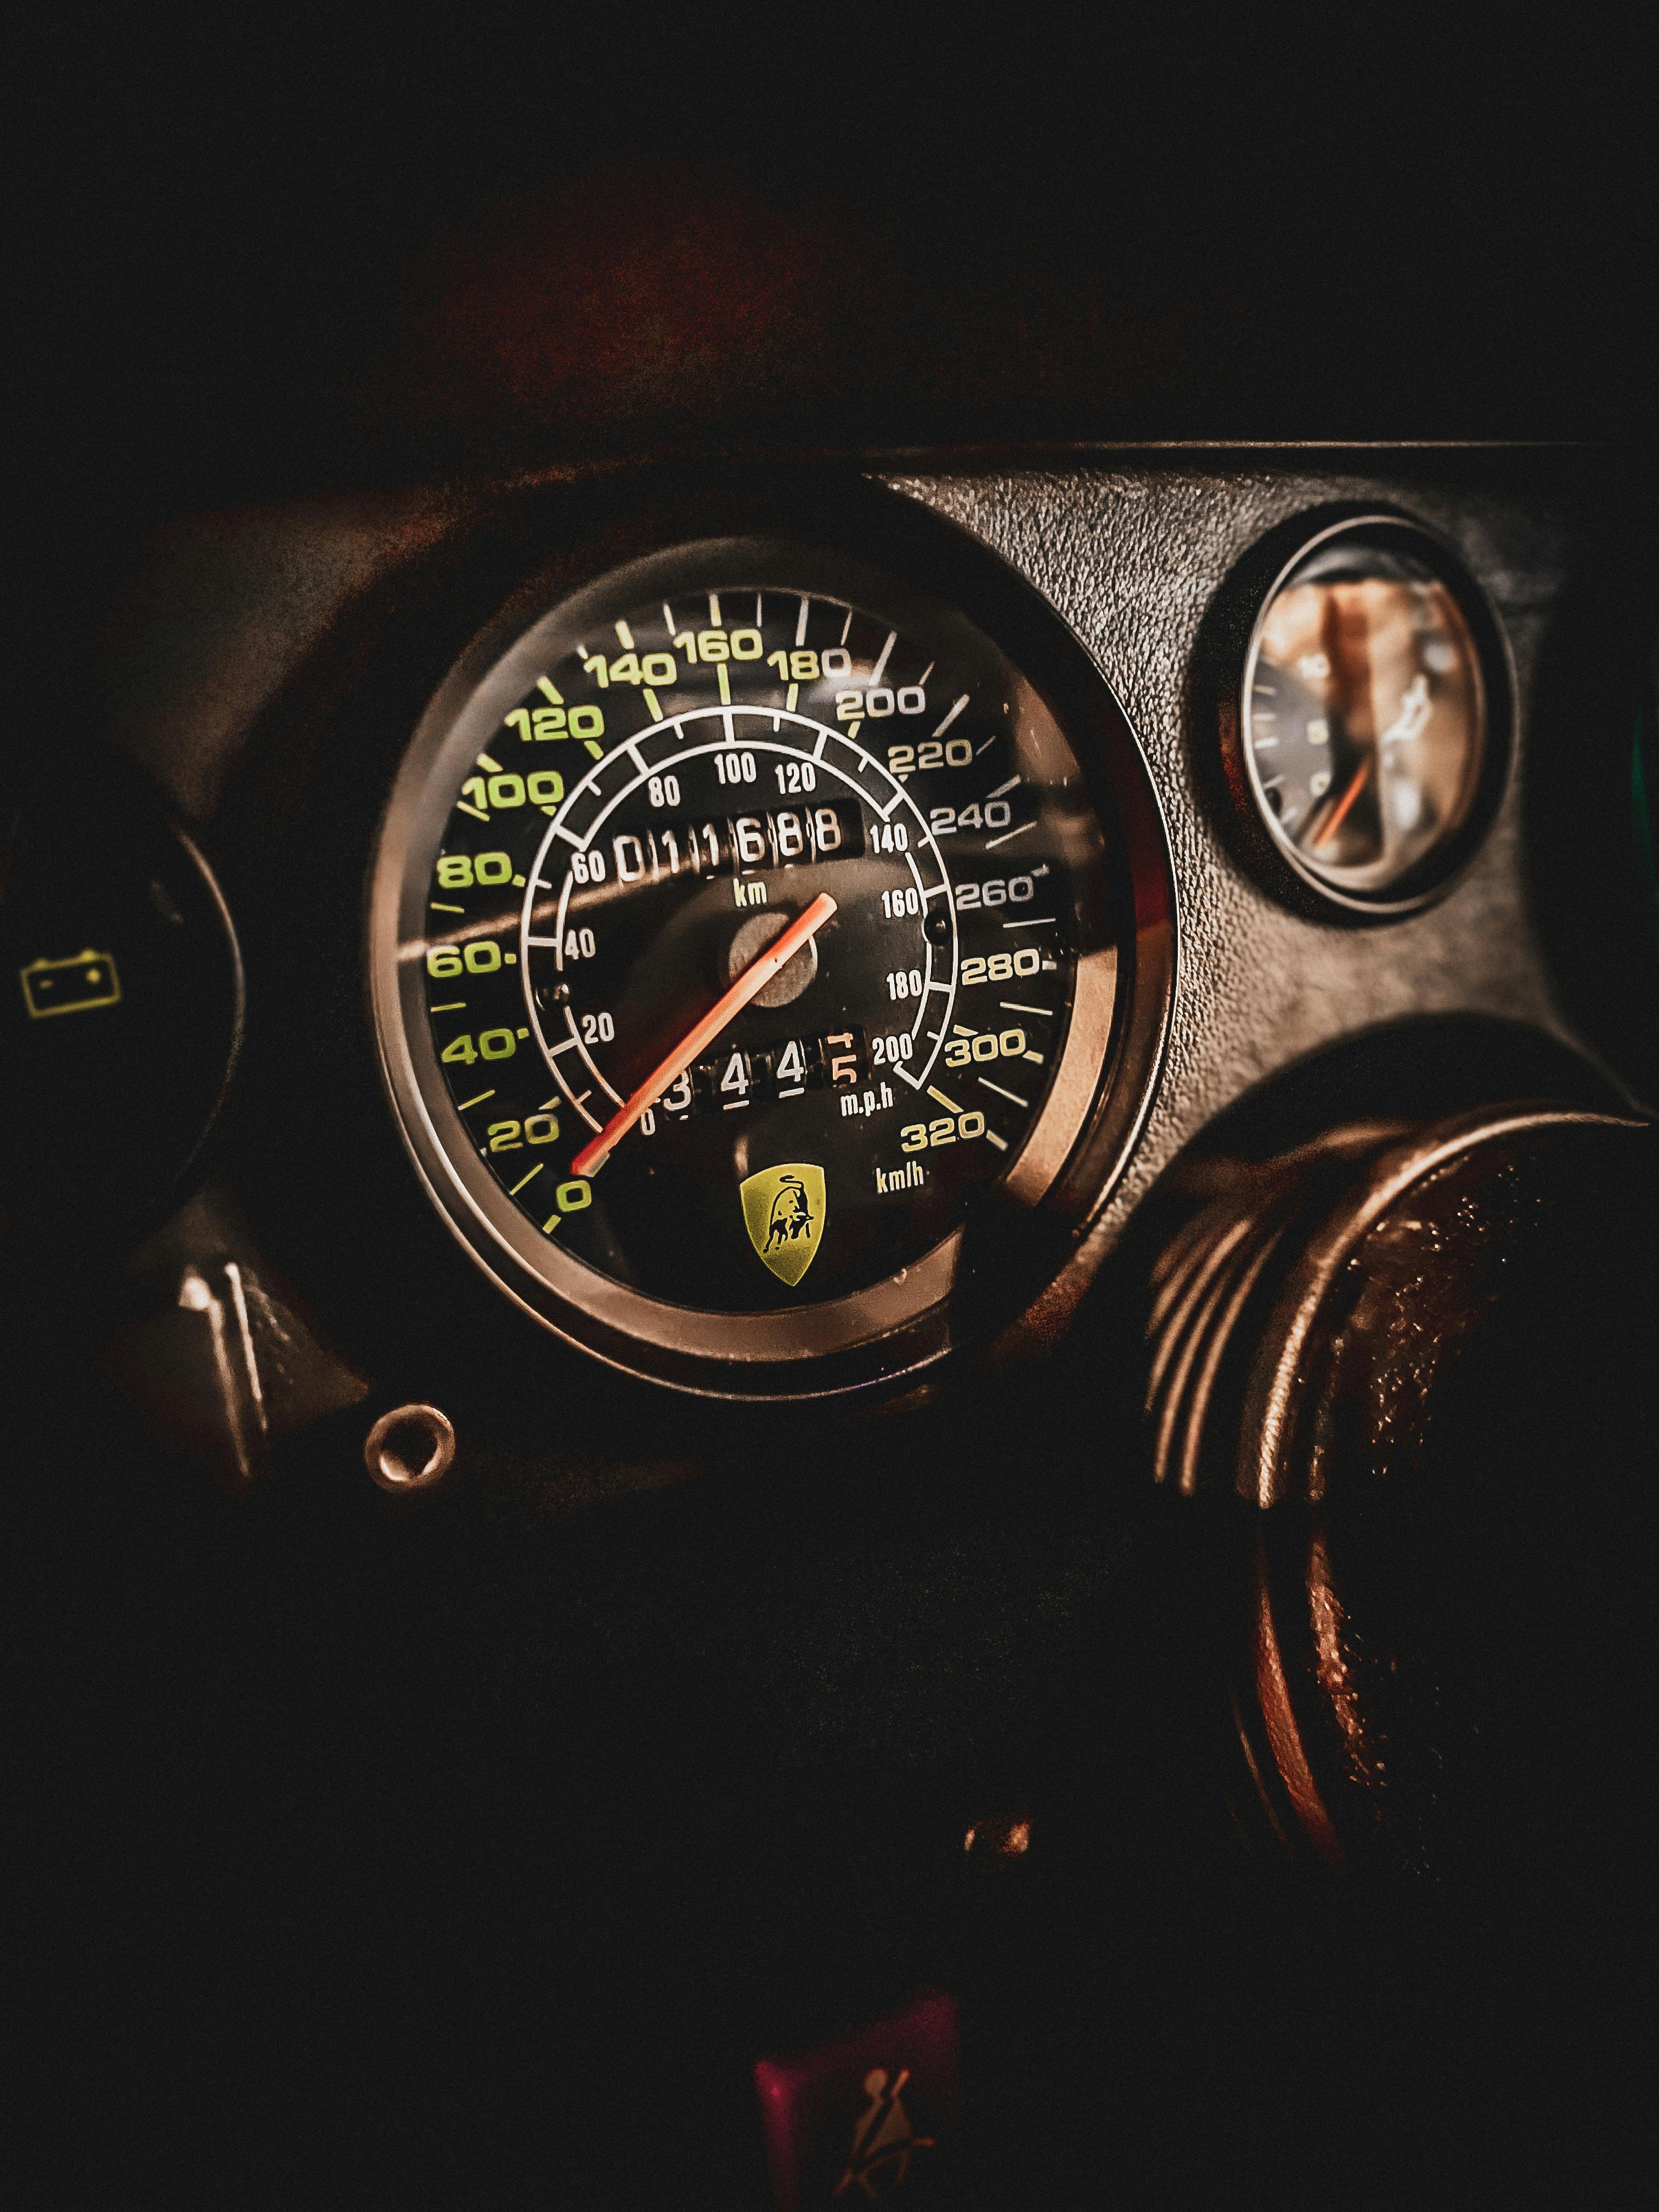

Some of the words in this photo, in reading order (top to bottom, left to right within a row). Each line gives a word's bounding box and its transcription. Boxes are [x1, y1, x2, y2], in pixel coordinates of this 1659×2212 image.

[674, 629, 763, 664] 160
[584, 653, 677, 688] 140
[768, 648, 852, 680] 180
[836, 686, 926, 721] 200
[505, 705, 604, 742] 120
[714, 752, 757, 784] 100
[888, 739, 972, 774] 220
[461, 770, 564, 809] 100
[649, 775, 680, 806] 80
[775, 763, 816, 794] 120
[930, 800, 1011, 836] 240
[870, 824, 908, 853] 140
[437, 851, 512, 889] 80
[571, 850, 606, 883] 60
[733, 878, 767, 907] km
[882, 887, 919, 918] 160
[956, 876, 1034, 910] 260
[427, 941, 501, 978] 60
[565, 927, 596, 960] 40
[961, 949, 1040, 985] 280
[887, 969, 921, 1000] 180
[582, 1012, 614, 1044] 20
[441, 1028, 517, 1064] 40
[873, 1033, 912, 1065] 200
[945, 1029, 1026, 1067] 300
[841, 1082, 893, 1116] m.p.h
[487, 1113, 558, 1153] 20
[640, 1108, 655, 1136] 0
[900, 1111, 985, 1152] 320
[876, 1161, 924, 1194] km/h
[556, 1180, 591, 1212] 0
